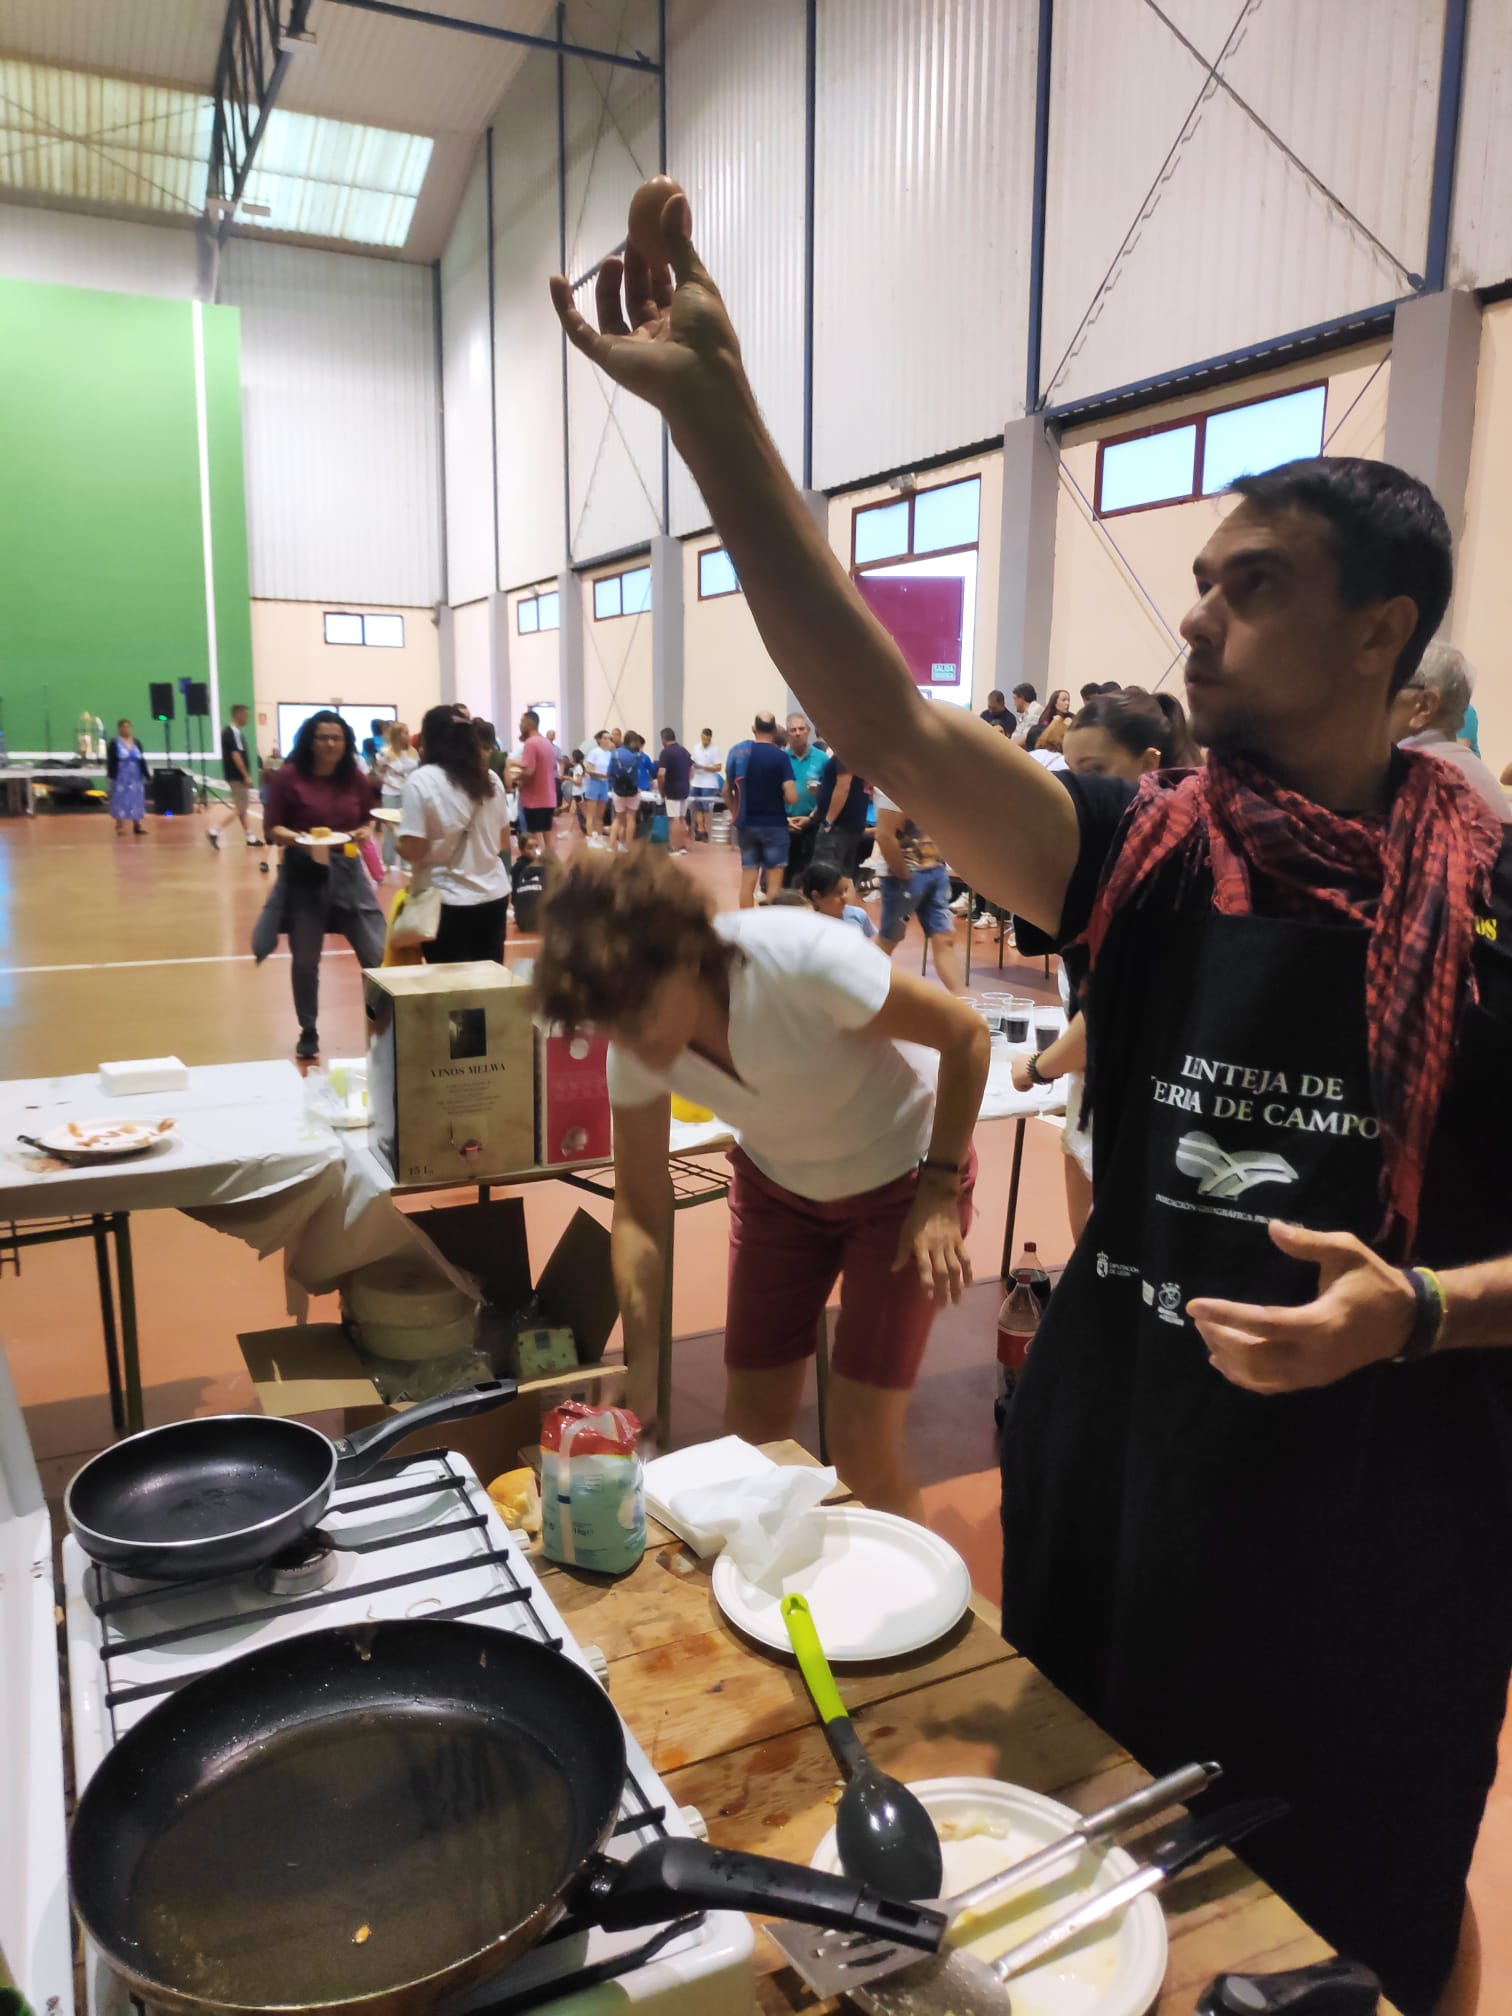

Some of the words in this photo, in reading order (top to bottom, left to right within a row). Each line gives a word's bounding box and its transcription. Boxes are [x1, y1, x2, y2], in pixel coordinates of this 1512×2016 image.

[431, 1068, 465, 1078] VINOS
[1299, 1073, 1344, 1100] DE
[1213, 1095, 1254, 1121] DE
